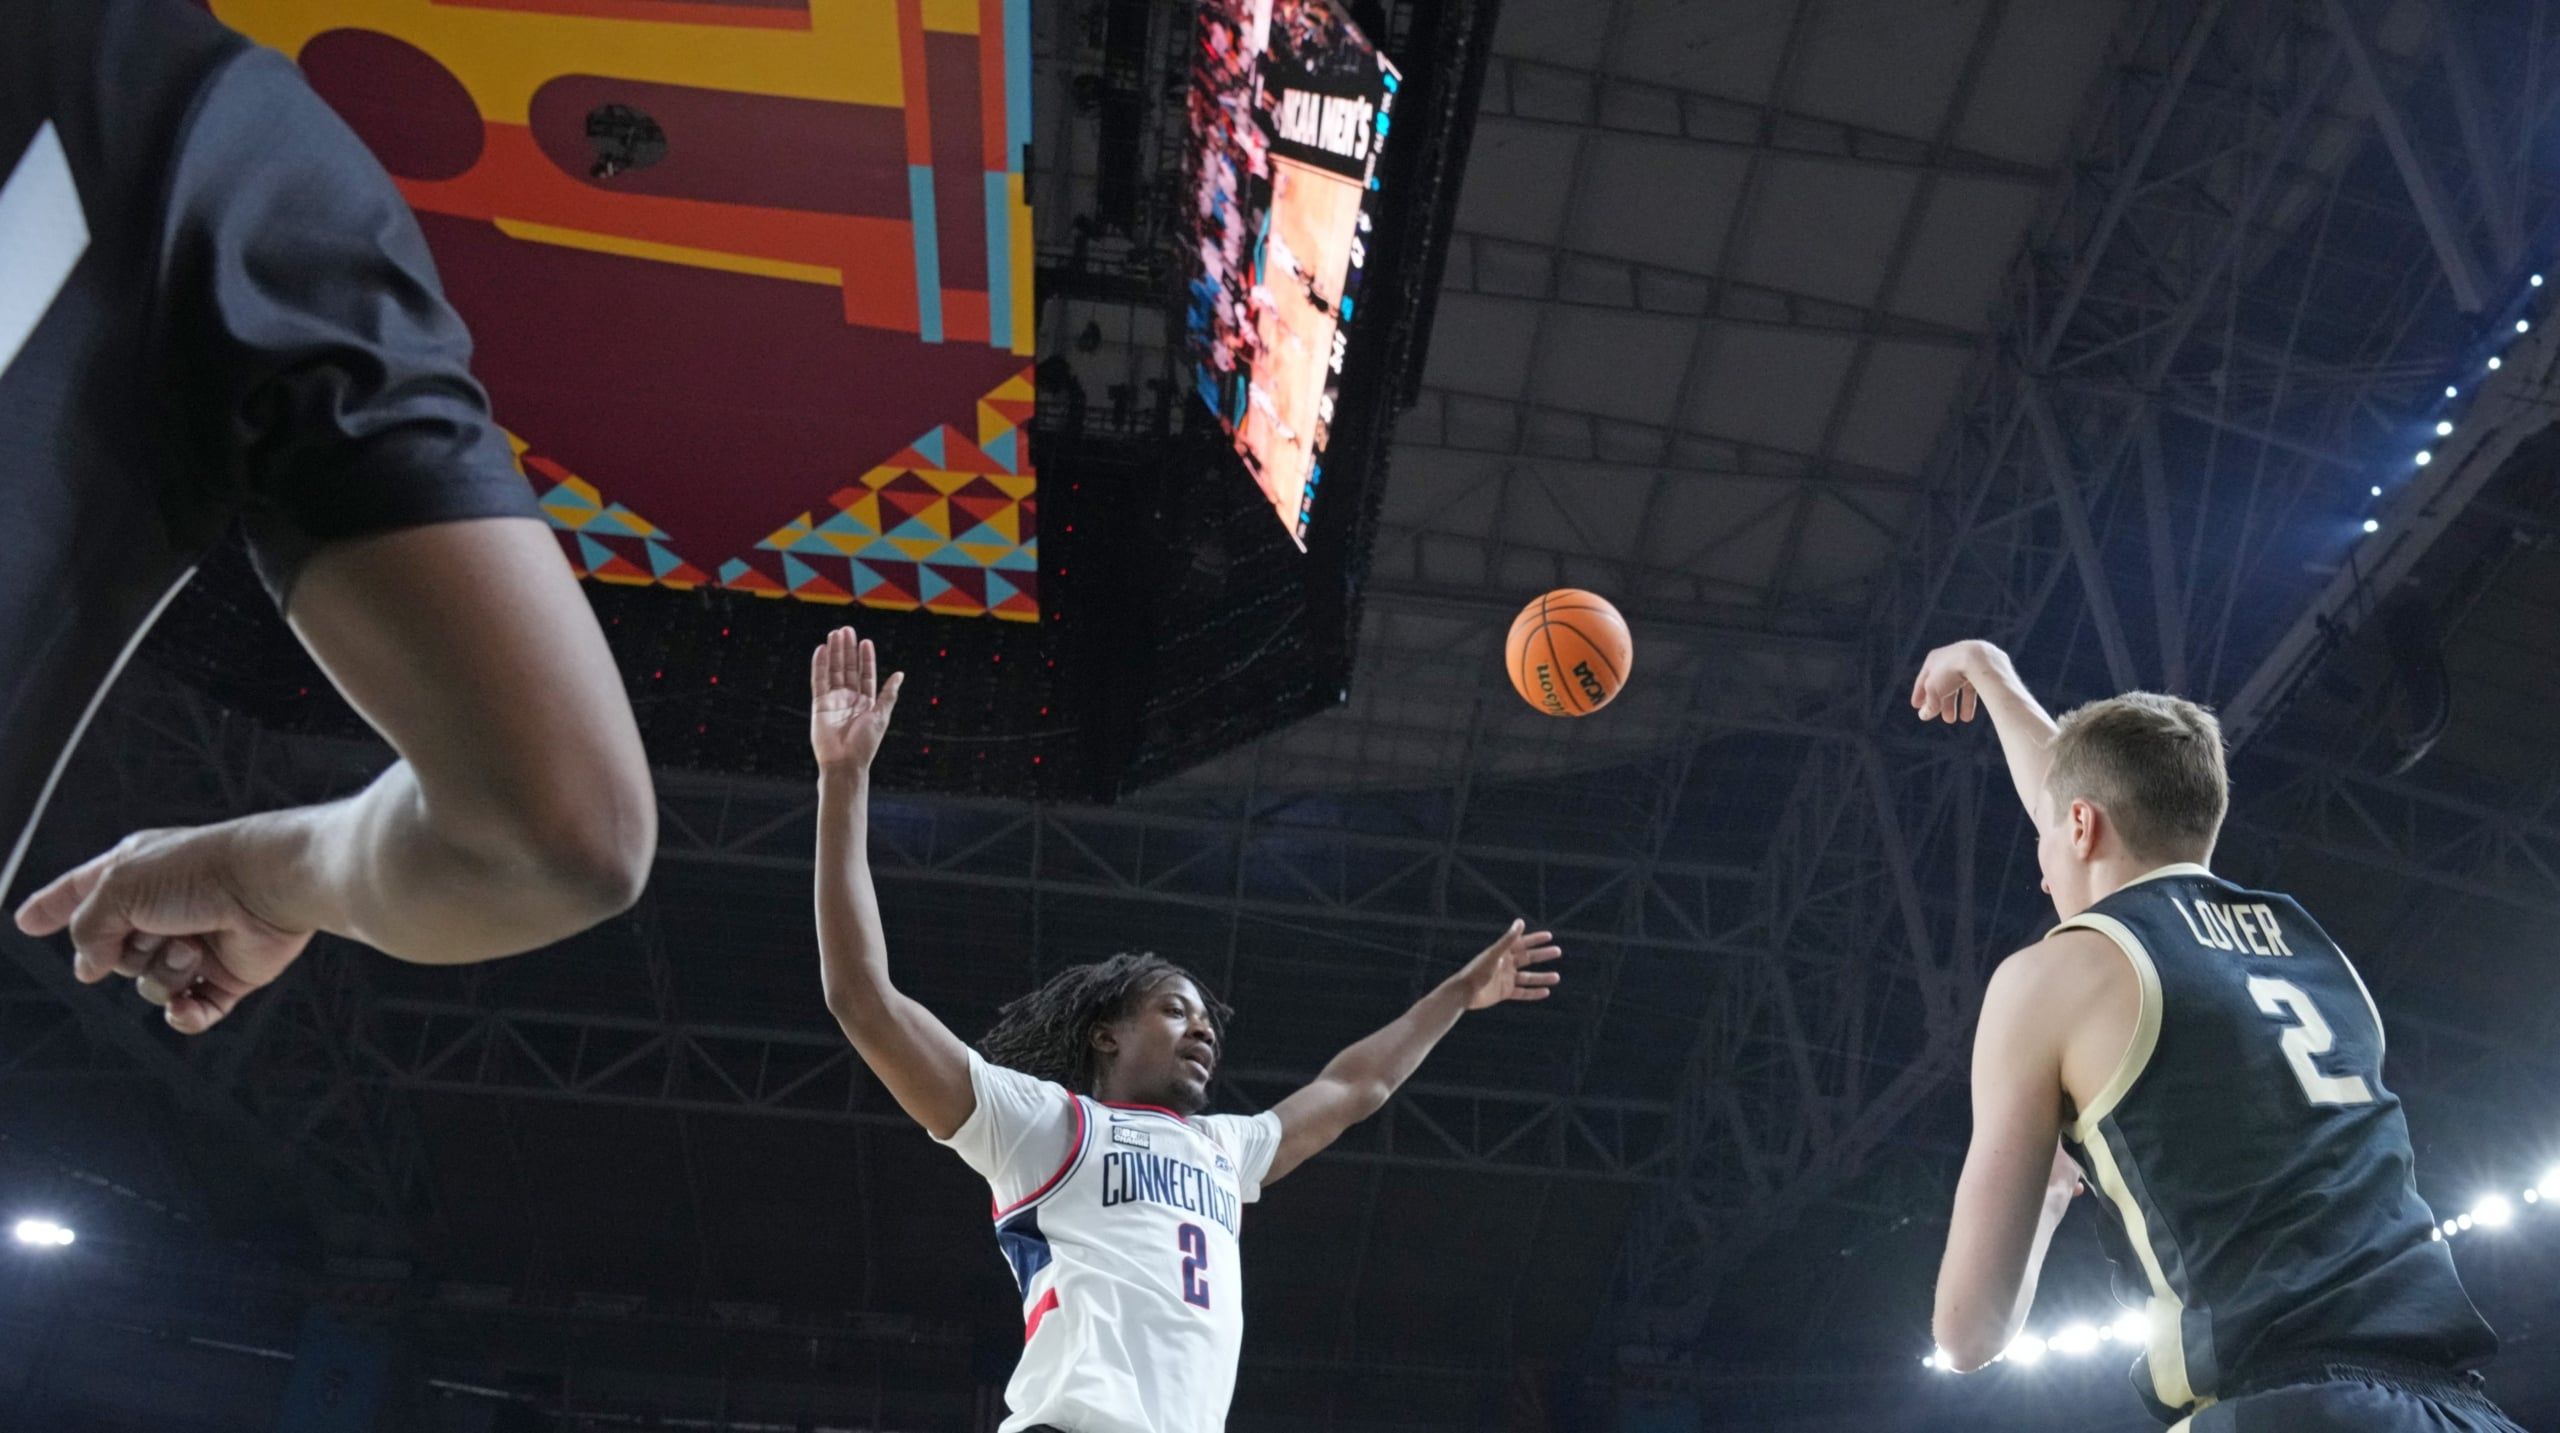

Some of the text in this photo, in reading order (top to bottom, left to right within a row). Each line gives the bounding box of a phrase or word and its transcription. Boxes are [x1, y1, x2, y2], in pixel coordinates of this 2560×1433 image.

[1573, 661, 1606, 706] NCAA
[2170, 896, 2294, 957] LOYER
[2246, 973, 2374, 1105] 2
[1178, 1222, 1210, 1310] 2
